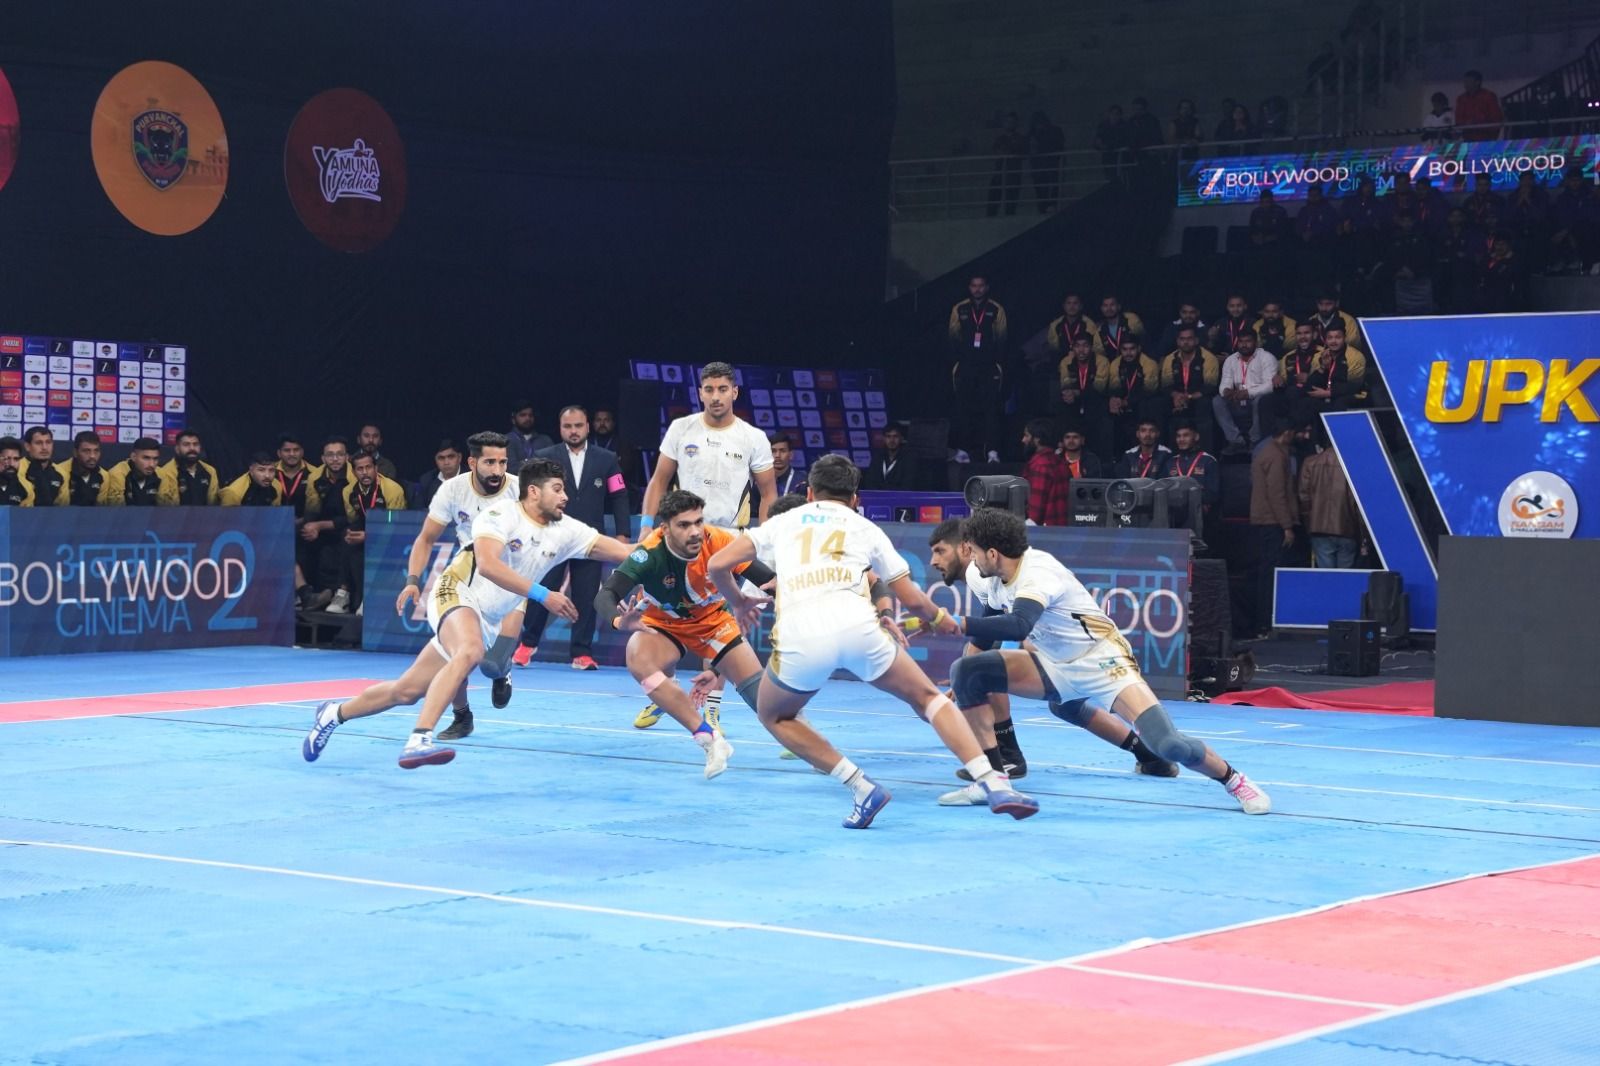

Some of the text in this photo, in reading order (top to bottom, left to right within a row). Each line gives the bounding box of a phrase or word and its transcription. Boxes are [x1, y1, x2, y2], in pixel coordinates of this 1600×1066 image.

[135, 112, 185, 136] PURVANCHAL
[312, 146, 380, 185] YAMUNA
[1226, 166, 1349, 187] BOLLYWOOD
[1429, 154, 1565, 176] BOLLYWOOD
[327, 170, 379, 201] Yodhas
[1425, 357, 1600, 424] UPK
[794, 526, 847, 566] 14
[0, 558, 247, 607] BOLLYWOOD
[207, 530, 258, 631] 2
[786, 566, 853, 593] SHAURYA
[56, 596, 193, 638] CINEMA
